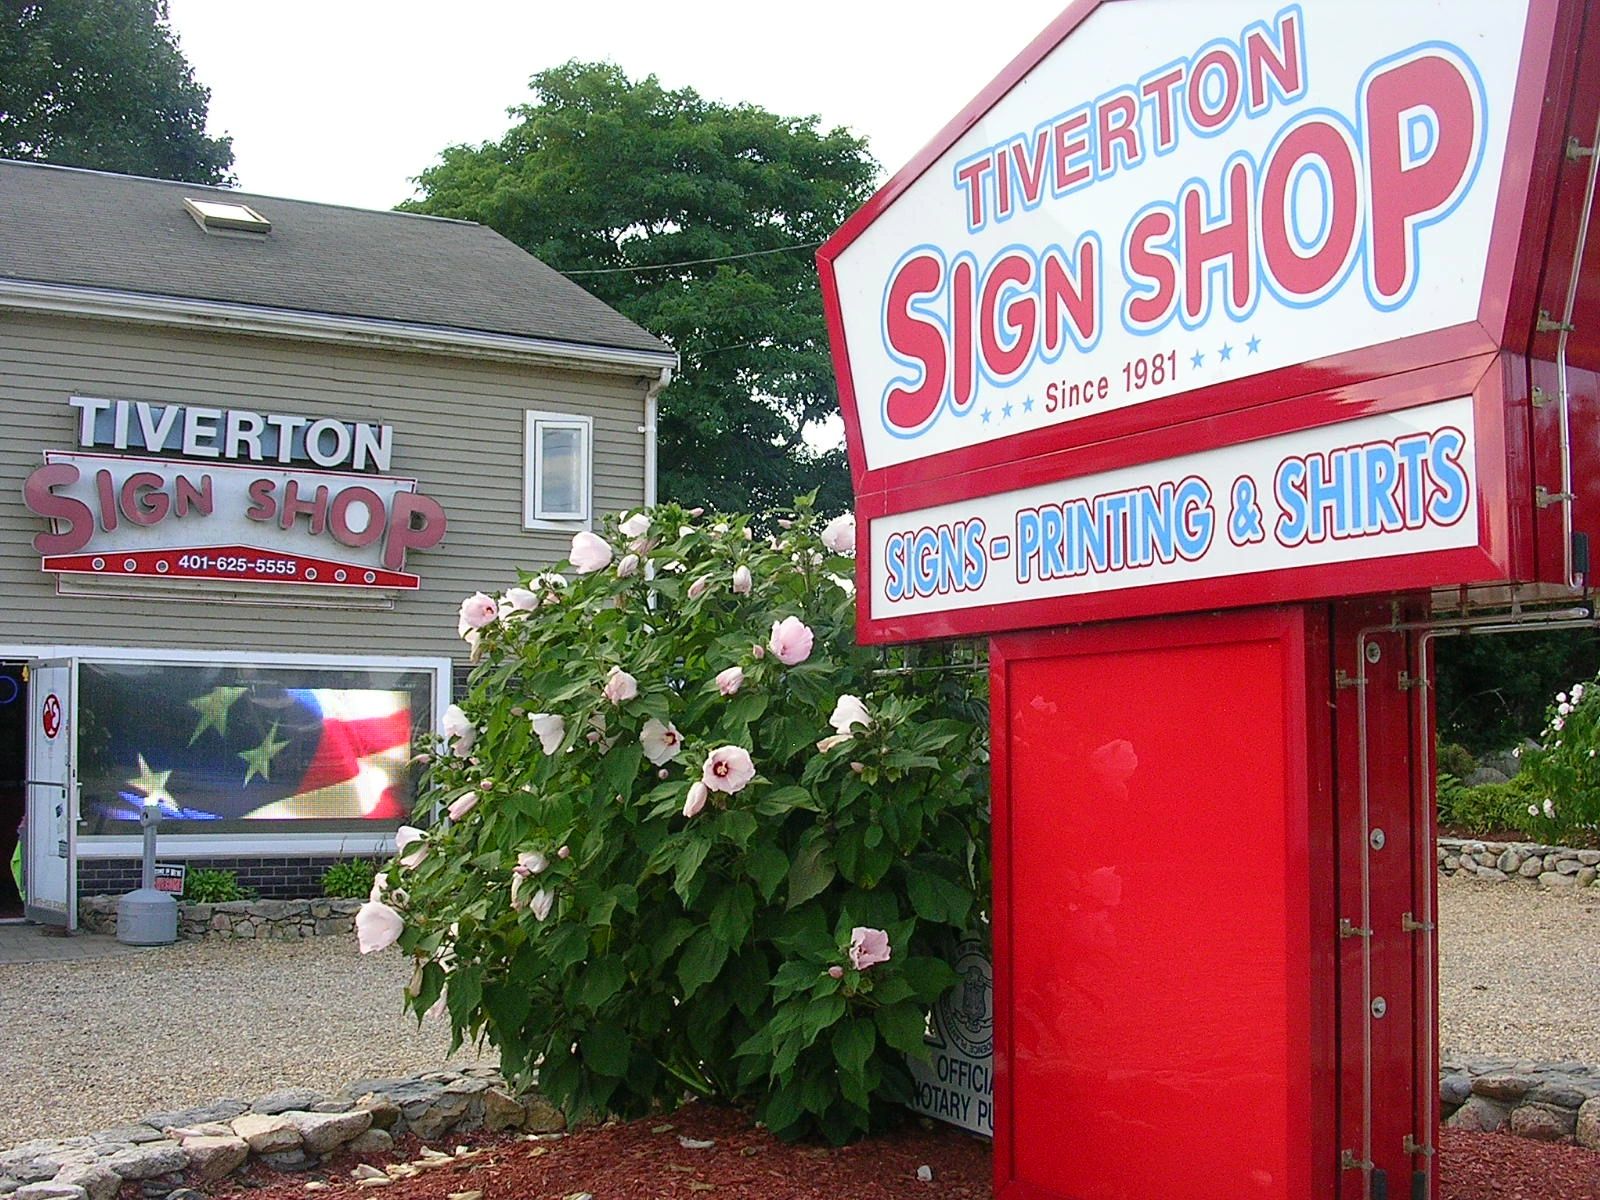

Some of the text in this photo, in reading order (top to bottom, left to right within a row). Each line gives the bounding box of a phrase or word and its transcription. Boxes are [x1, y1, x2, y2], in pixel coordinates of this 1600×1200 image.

[955, 5, 1304, 232] TIVERTON
[881, 41, 1488, 438] SIGN SHOP
[69, 396, 393, 472] TIVERTON
[1045, 349, 1179, 414] Since 1981
[22, 463, 447, 571] SIGN SHOP
[178, 554, 297, 575] 401-625-5555
[885, 517, 986, 602] SIGNS
[1016, 474, 1215, 584] PRINTING
[1228, 475, 1265, 547] &
[1274, 426, 1471, 549] SHIRTS
